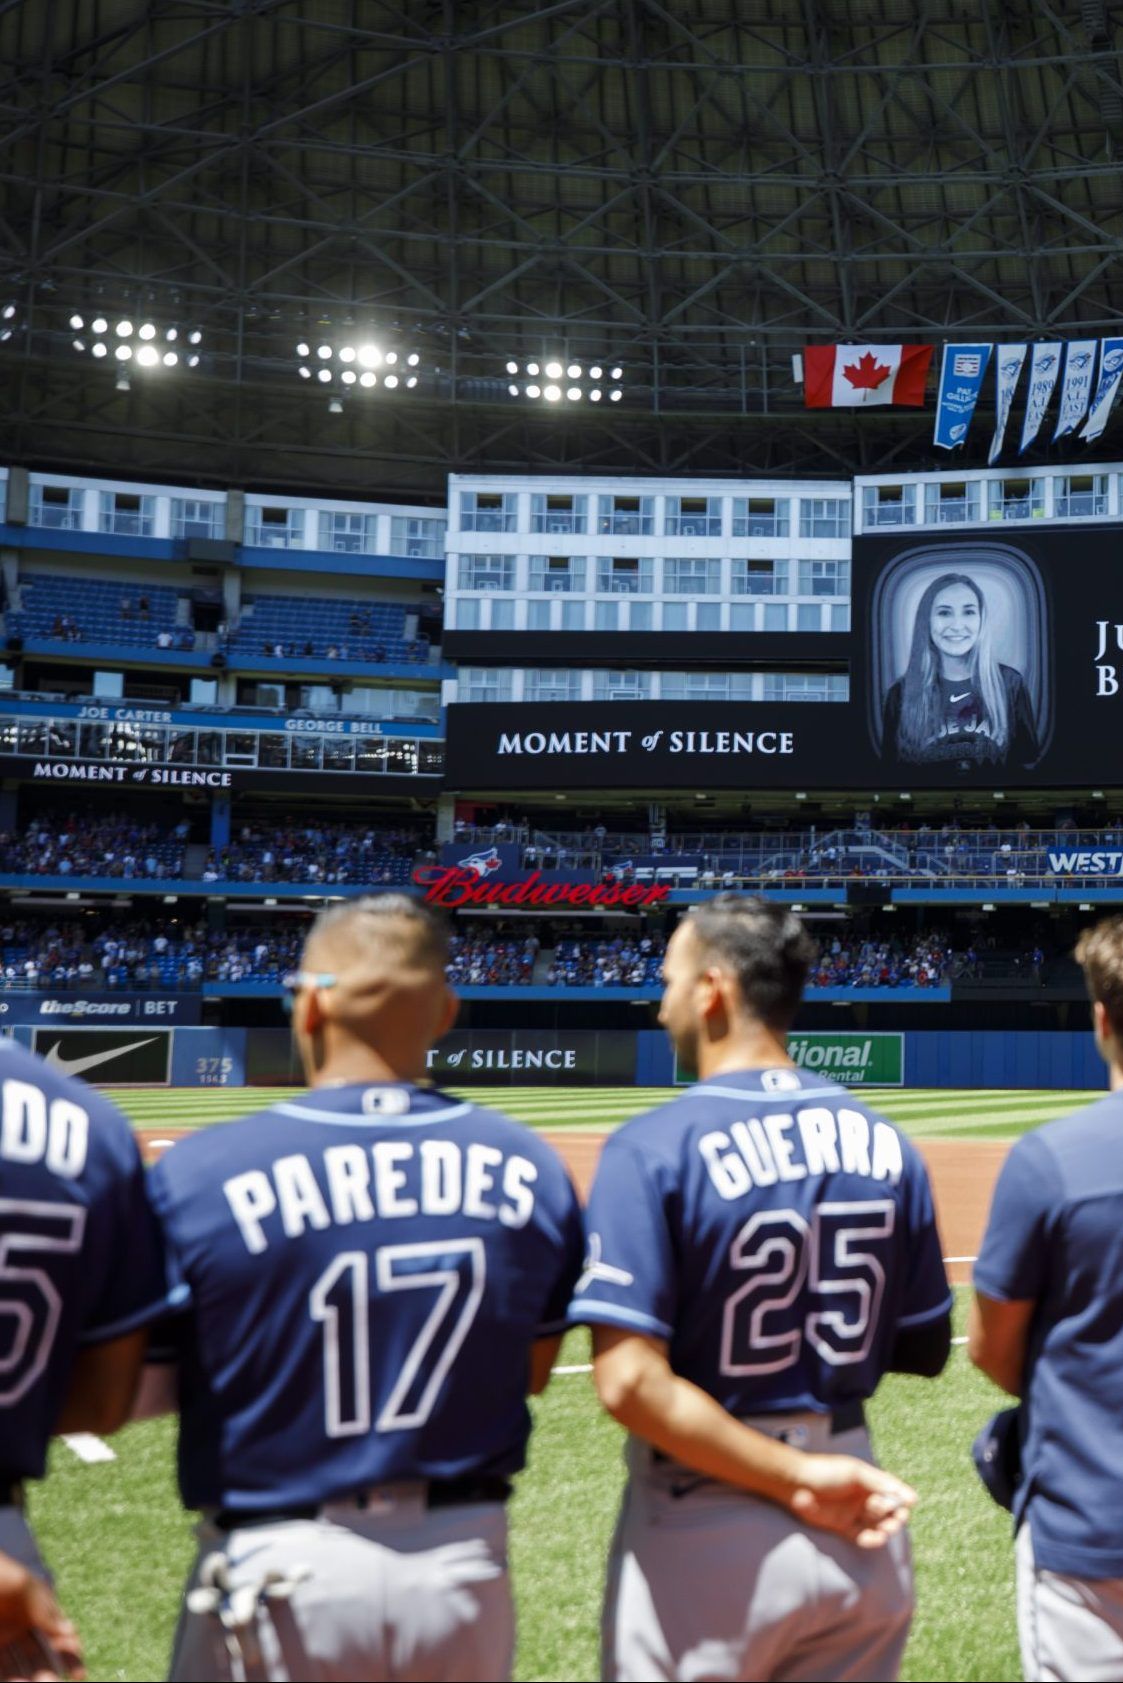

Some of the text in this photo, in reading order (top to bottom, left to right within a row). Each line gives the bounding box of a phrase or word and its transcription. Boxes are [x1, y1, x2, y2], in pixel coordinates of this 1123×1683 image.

[77, 706, 173, 723] JOE CARTER
[285, 719, 383, 734] GEORGE BELL
[497, 730, 794, 754] MOMENT of SILENCE
[34, 762, 232, 787] MOMENT of SILENCE
[412, 864, 671, 907] Budweiser
[39, 1000, 178, 1015] theScore BET
[196, 1057, 233, 1074] 375
[447, 1048, 468, 1067] of
[471, 1049, 577, 1069] SILENCE
[786, 1040, 874, 1067] tional.
[817, 1069, 865, 1082] Rental
[698, 1107, 902, 1201] GUERRA
[224, 1140, 538, 1254] PAREDES
[720, 1199, 895, 1377] 25
[309, 1237, 486, 1437] 17
